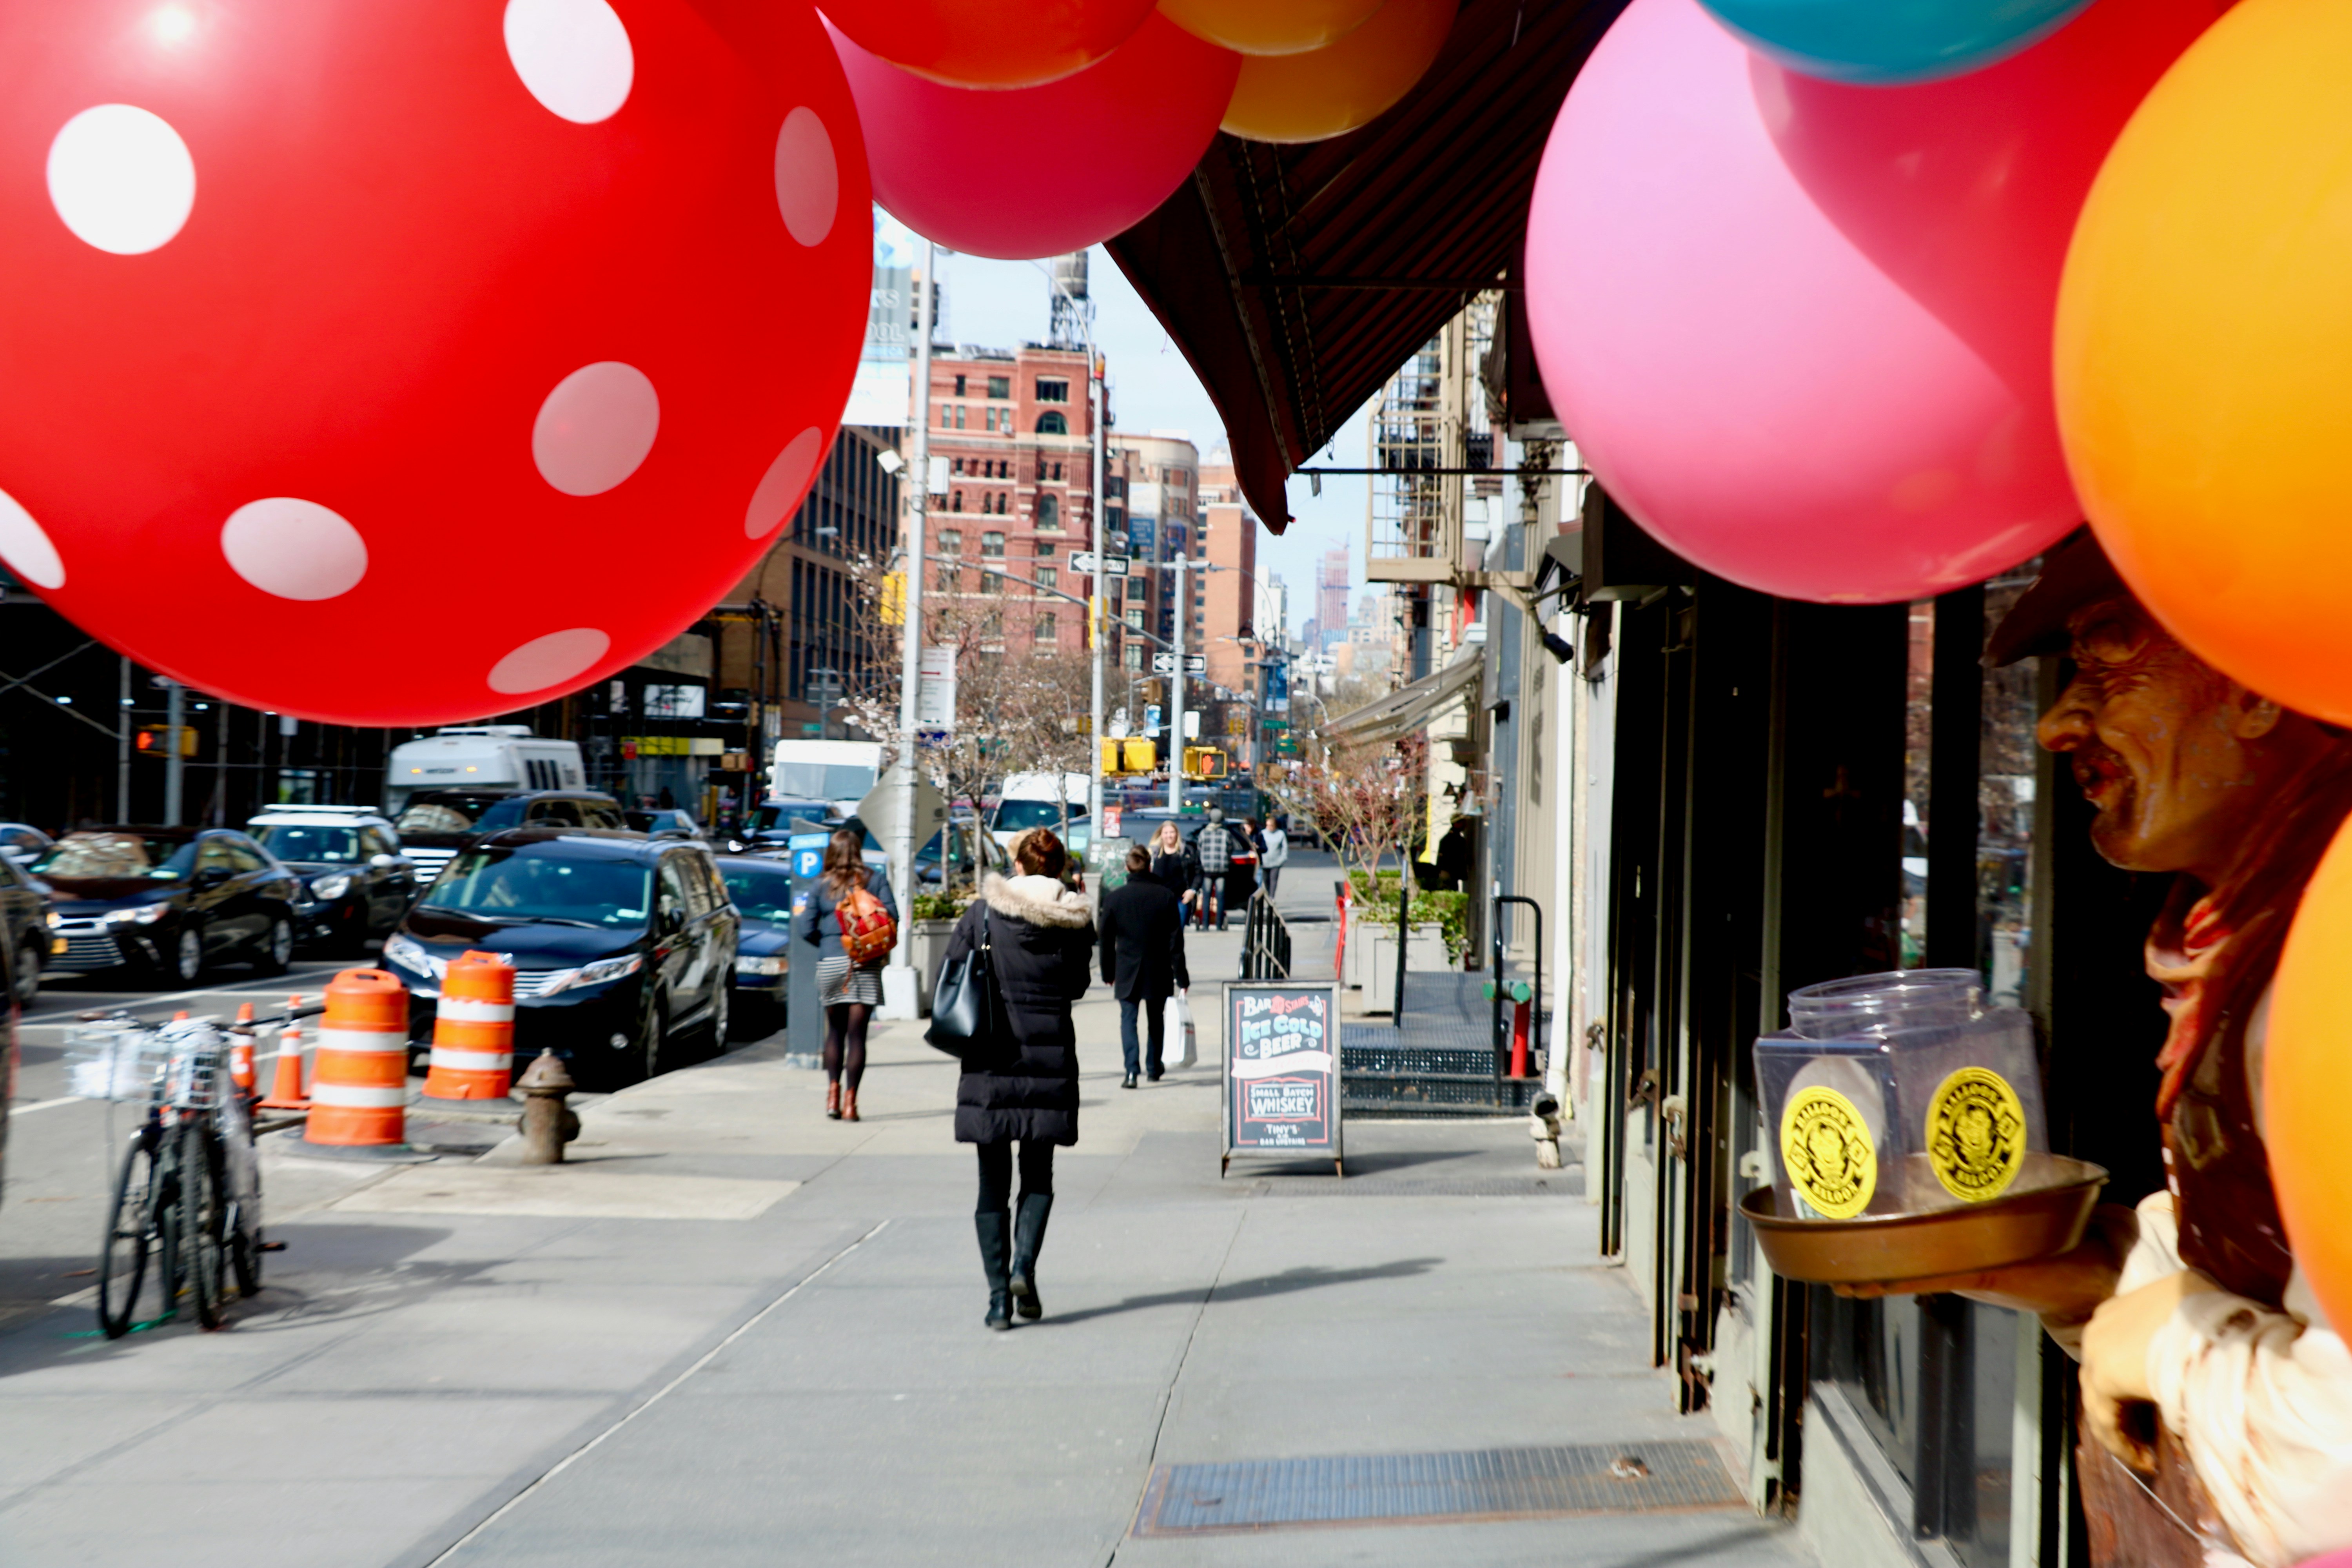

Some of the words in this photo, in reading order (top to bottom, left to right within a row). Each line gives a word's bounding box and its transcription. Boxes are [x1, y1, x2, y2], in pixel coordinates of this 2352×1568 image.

[801, 852, 817, 875] P
[1243, 996, 1272, 1016] BAR
[1285, 995, 1310, 1013] STAIRS
[1241, 1019, 1271, 1044] ICE
[1273, 1014, 1323, 1038] COLD
[1260, 1033, 1302, 1058] BEER
[1250, 1087, 1279, 1098] SMALL
[1283, 1087, 1314, 1098] BATCH
[1942, 1083, 1998, 1114] BALLOON
[1250, 1097, 1314, 1114] WHISKEY
[1795, 1102, 1849, 1129] BALLOON
[1266, 1123, 1298, 1134] TINY'S
[1957, 1158, 2006, 1186] SALOON
[1812, 1180, 1858, 1203] SALOON
